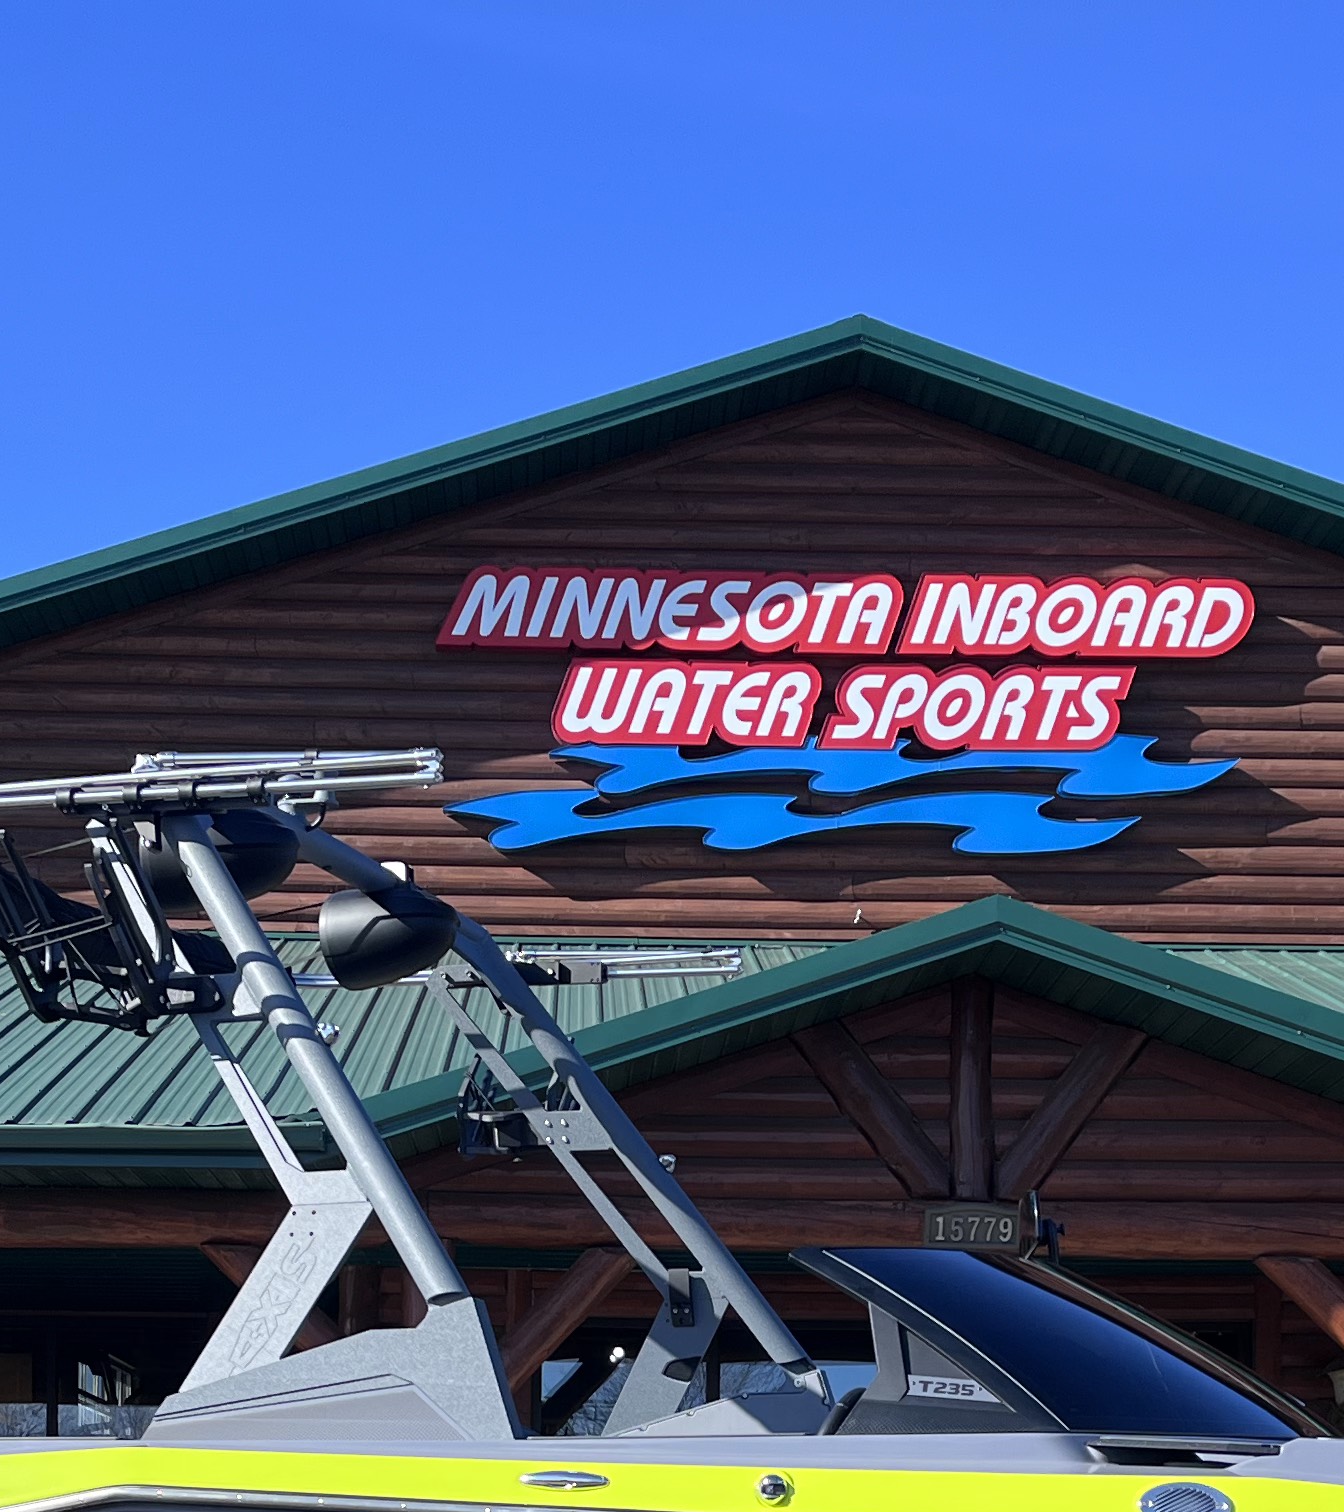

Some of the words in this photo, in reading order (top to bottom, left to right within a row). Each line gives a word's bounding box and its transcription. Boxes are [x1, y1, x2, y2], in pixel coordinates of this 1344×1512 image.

[452, 574, 899, 644] MINNESOTA
[907, 581, 1245, 649] INBOARD
[558, 665, 811, 738] WATER
[831, 673, 1123, 743] SPORTS
[935, 1216, 1013, 1242] 15779
[918, 1380, 975, 1397] T235
